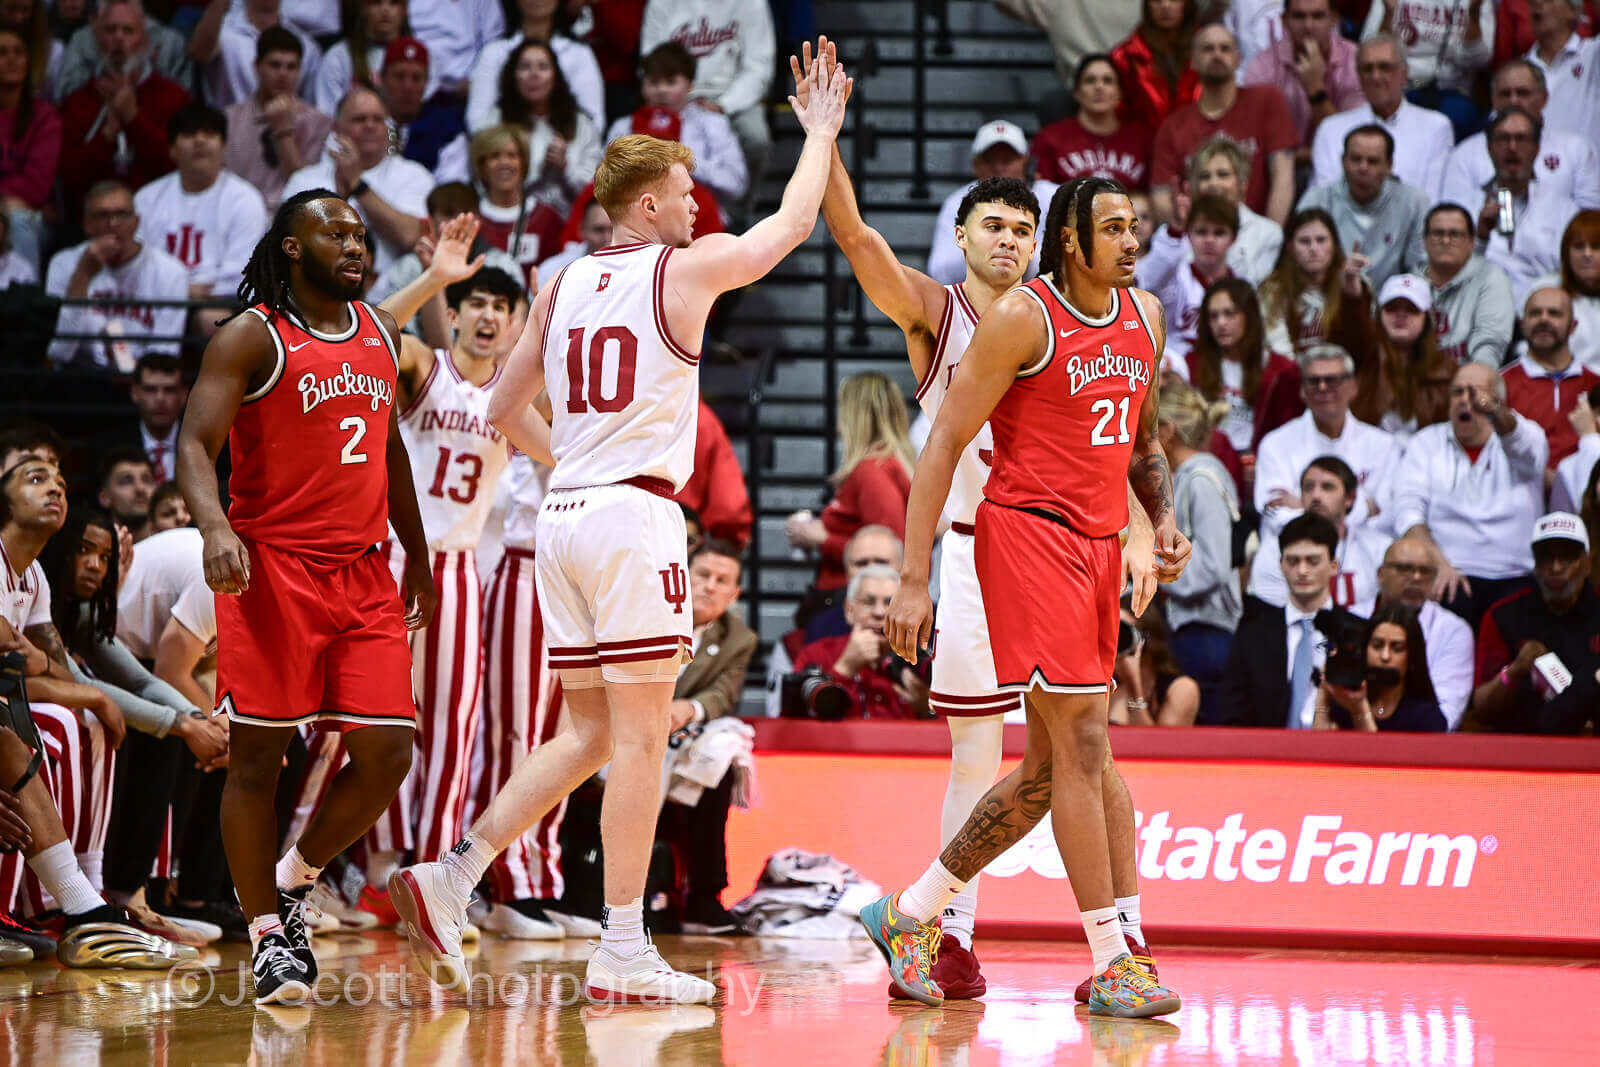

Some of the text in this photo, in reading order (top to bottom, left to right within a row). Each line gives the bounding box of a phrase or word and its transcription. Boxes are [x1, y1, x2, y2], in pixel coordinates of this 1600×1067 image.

[297, 361, 393, 414] Buckeyes
[566, 325, 638, 414] 10
[1066, 344, 1150, 396] Buckeyes
[339, 416, 368, 465] 2
[421, 409, 502, 444] INDIAN
[1090, 396, 1131, 447] 21
[428, 446, 483, 504] 13
[658, 562, 686, 614] IU
[1134, 810, 1287, 883] tate
